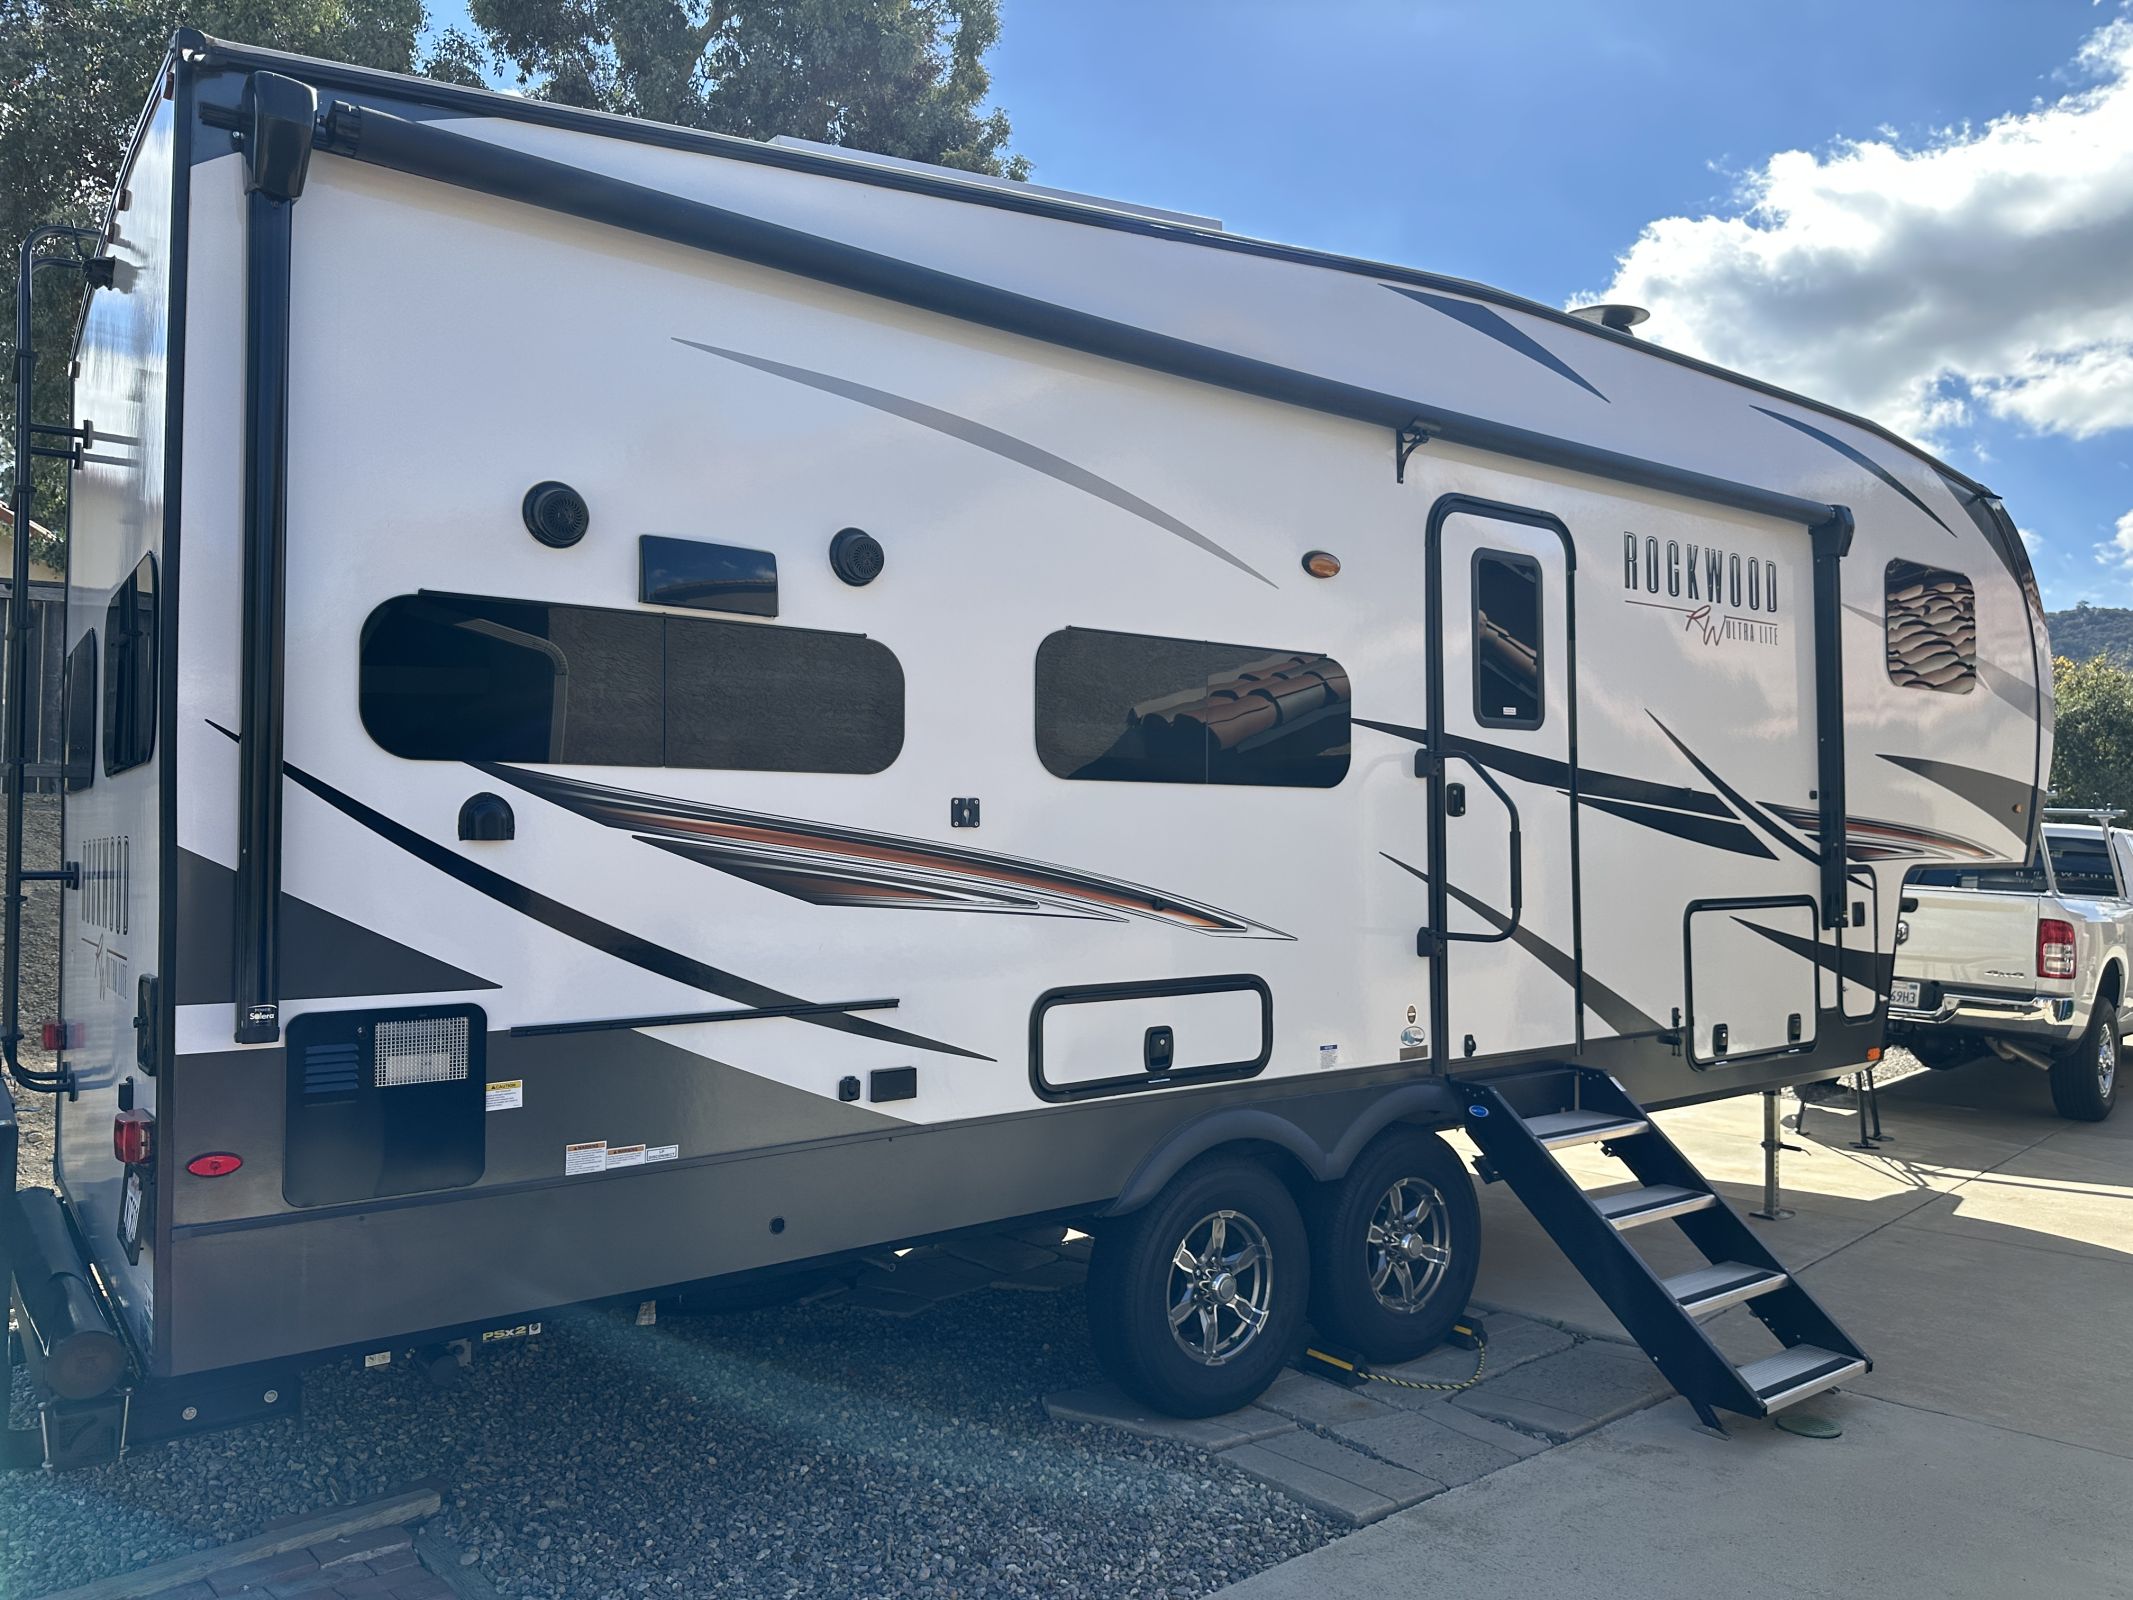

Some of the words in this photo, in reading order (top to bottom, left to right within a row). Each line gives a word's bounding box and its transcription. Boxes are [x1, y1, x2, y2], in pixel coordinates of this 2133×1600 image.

[1624, 531, 1777, 613] ROCKWOOD
[1725, 620, 1755, 642] ULTRA
[1760, 625, 1778, 646] LITE
[249, 1012, 275, 1020] Solera
[482, 1325, 527, 1341] PSx2
